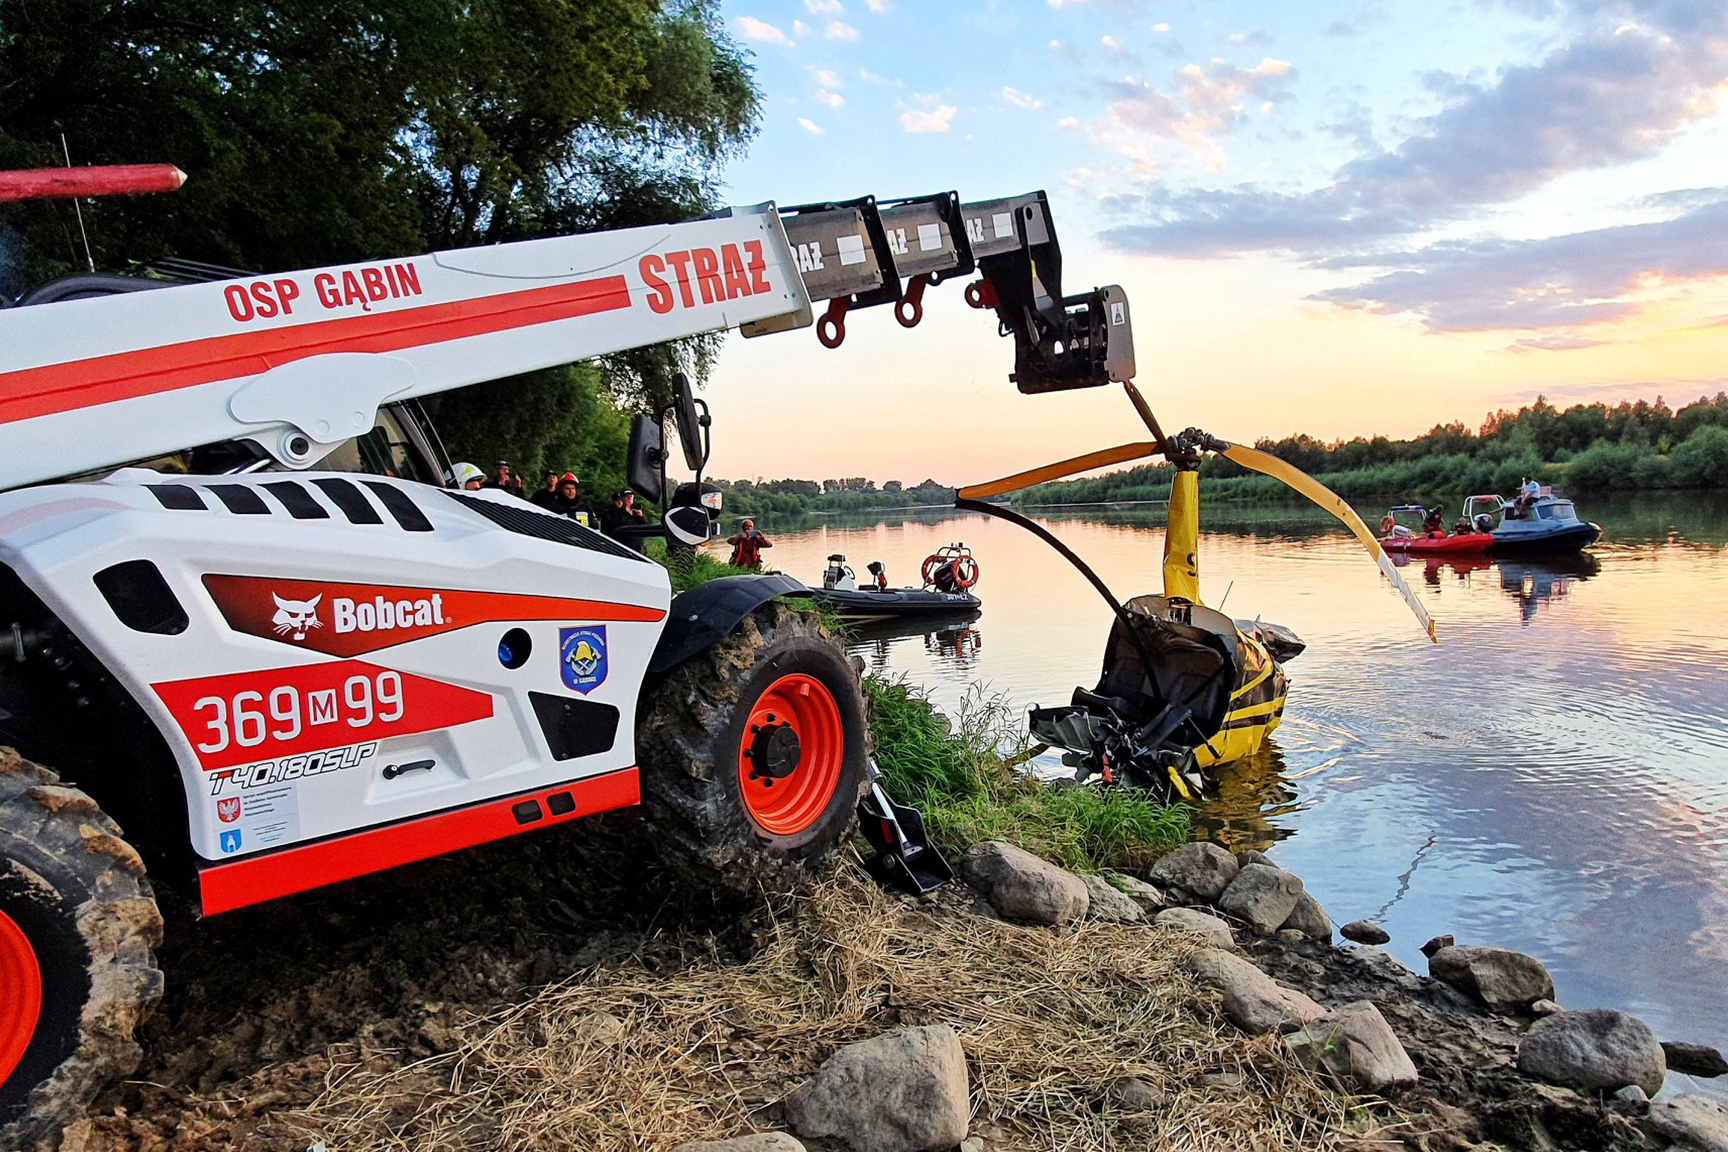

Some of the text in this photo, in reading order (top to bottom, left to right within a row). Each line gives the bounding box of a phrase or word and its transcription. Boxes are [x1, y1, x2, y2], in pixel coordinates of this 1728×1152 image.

[223, 262, 423, 322] OSP GĄBIN
[333, 593, 444, 634] Bobcat
[208, 741, 378, 796] T40.180SLP
